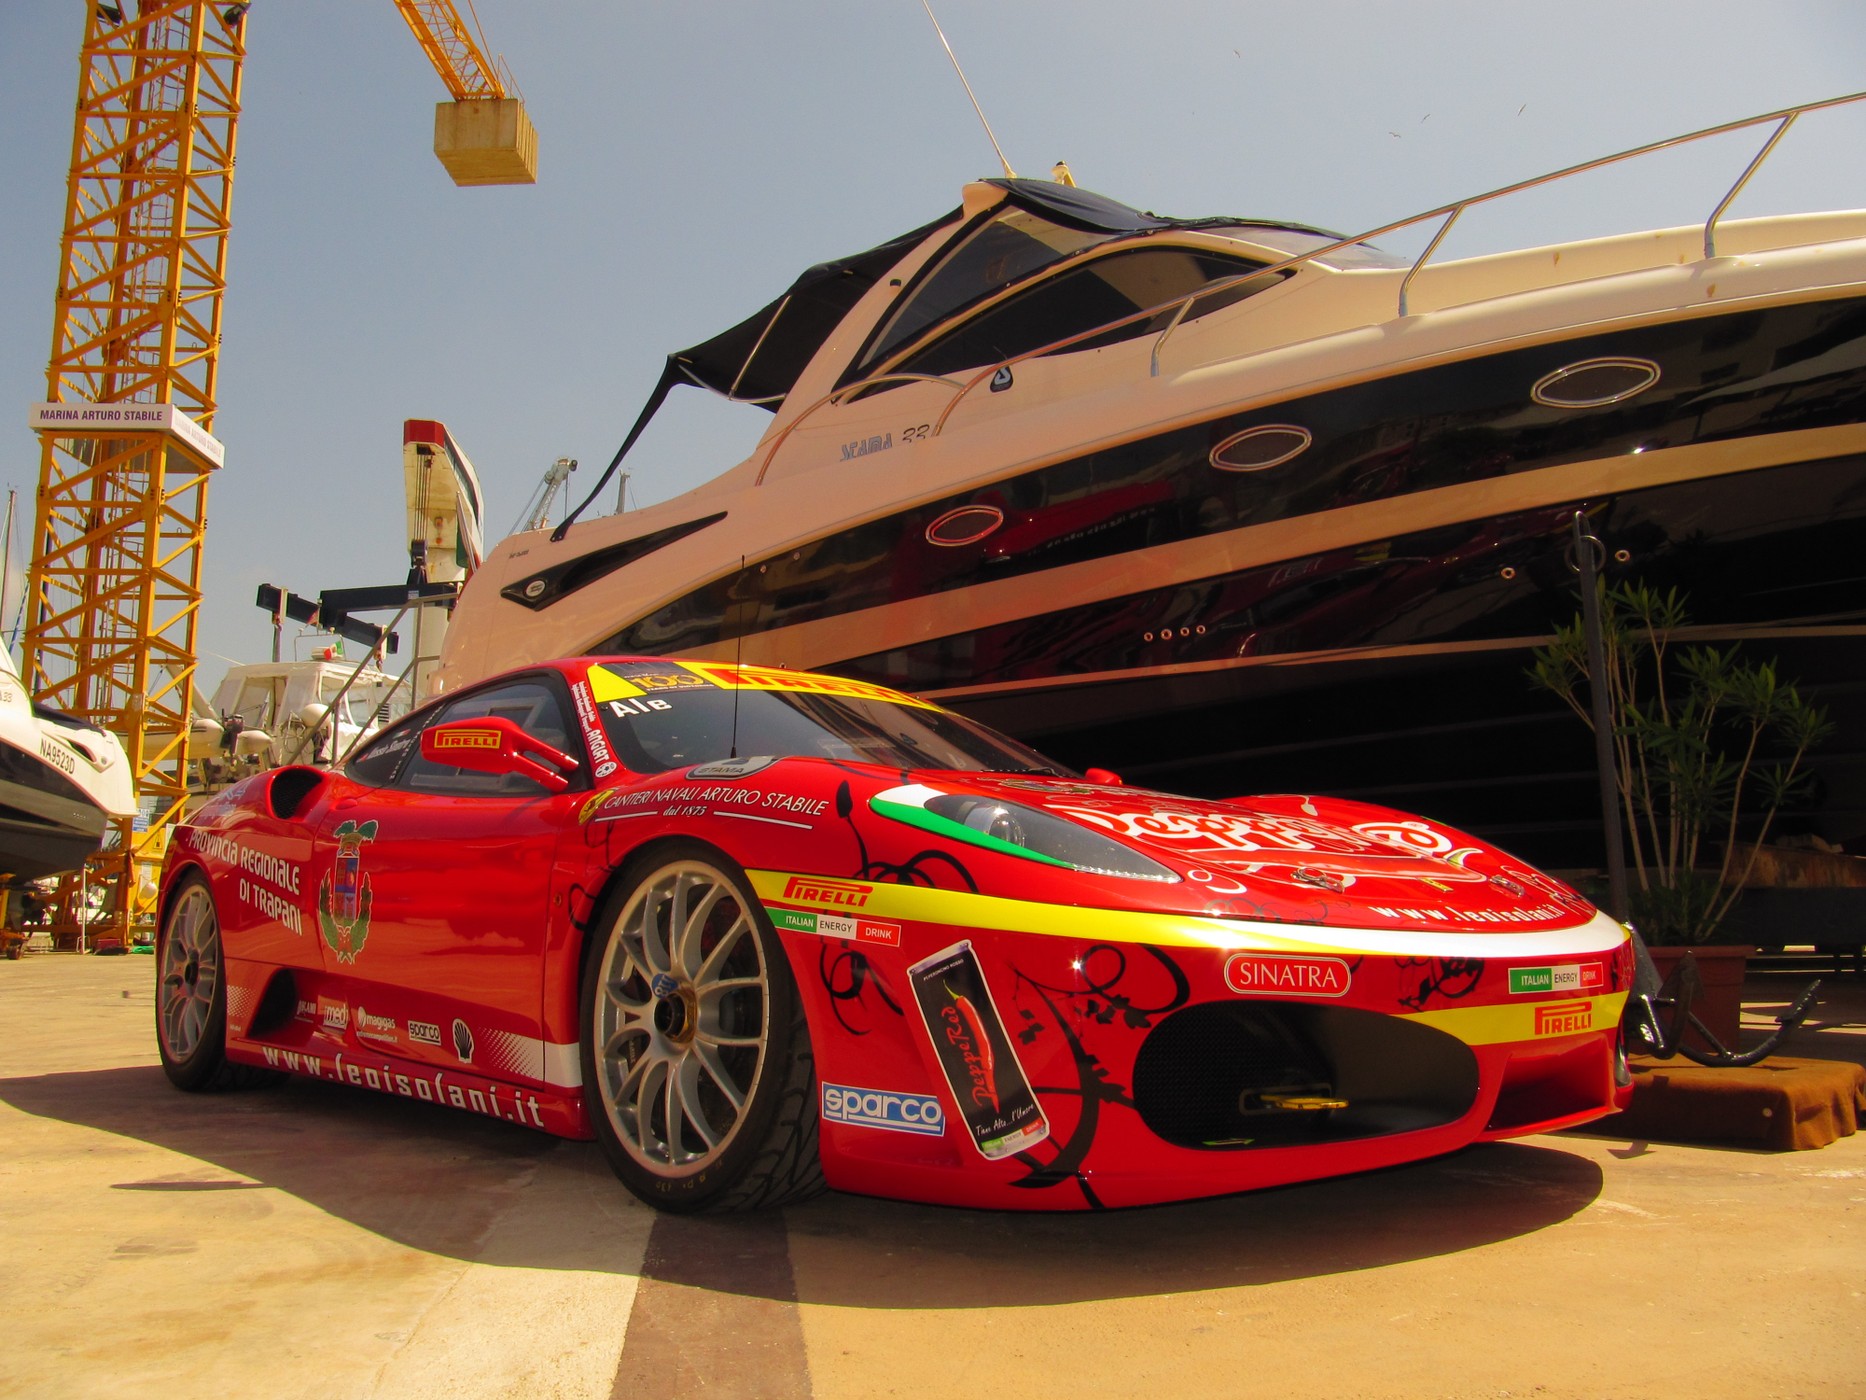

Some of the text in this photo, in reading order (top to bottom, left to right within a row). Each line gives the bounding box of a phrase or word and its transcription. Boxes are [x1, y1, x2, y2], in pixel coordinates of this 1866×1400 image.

[40, 410, 163, 421] MARINA ARTURO STABILE
[437, 731, 499, 748] PIRELLI
[40, 738, 76, 774] NA9523D
[604, 787, 829, 816] CANTIERI NAVALI ARTURO STABILE
[663, 806, 708, 817] dal 1875
[240, 846, 300, 896] REGIONALE
[783, 876, 874, 907] PIRELLI
[239, 878, 303, 936] DI TRAPANI
[785, 915, 891, 939] ITALIAN ENERGY DRINK
[1239, 962, 1338, 988] SINATRA
[1521, 971, 1597, 986] ITALIAN ENERGY DRINK
[366, 1014, 396, 1031] magigas
[1534, 1001, 1592, 1035] PIRELLI
[409, 1023, 440, 1040] sparco
[825, 1089, 942, 1125] sparco
